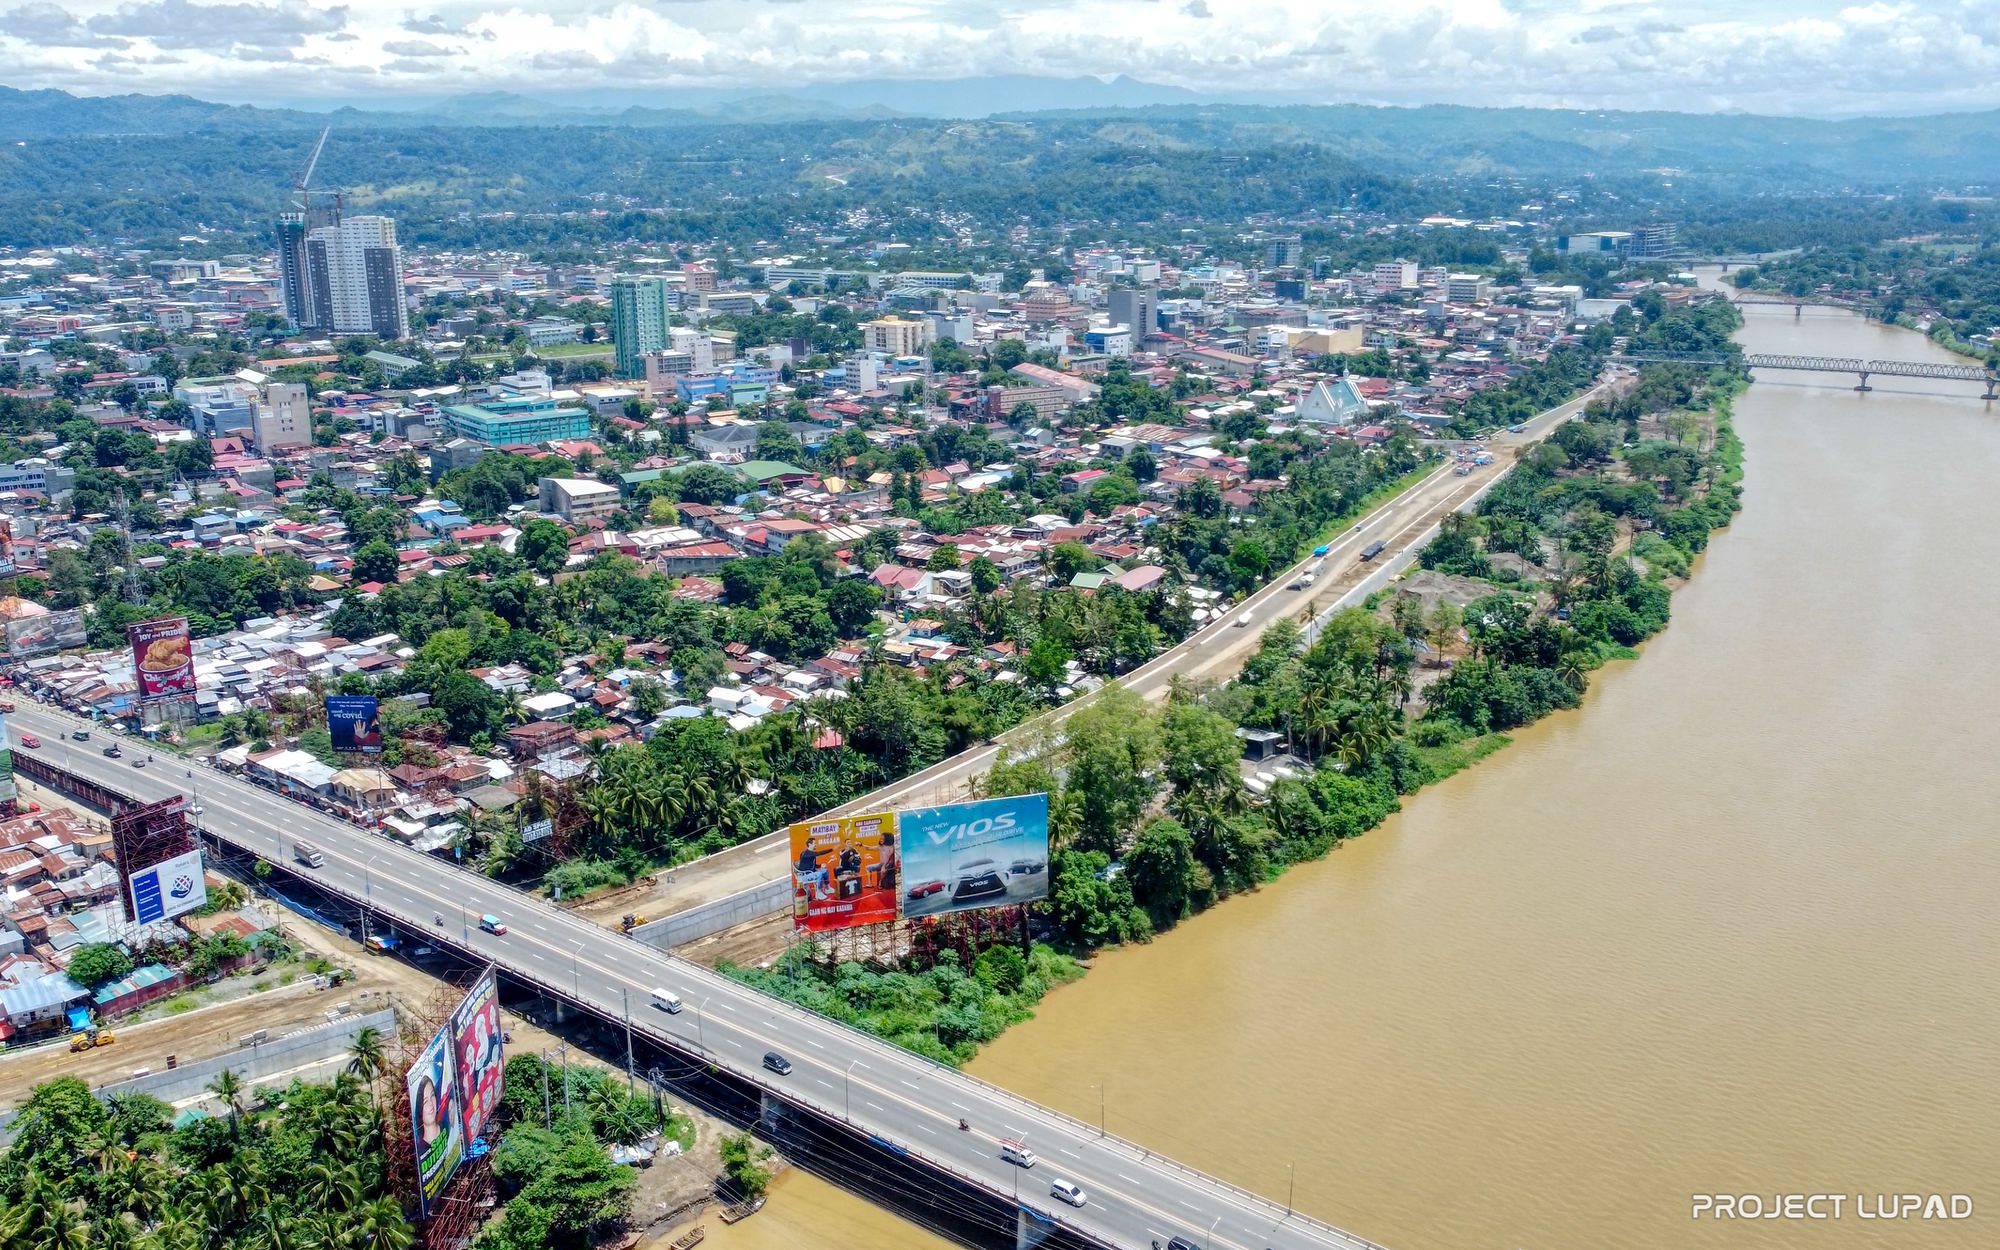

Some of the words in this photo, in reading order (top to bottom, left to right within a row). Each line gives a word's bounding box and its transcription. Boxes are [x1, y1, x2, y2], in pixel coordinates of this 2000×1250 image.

[139, 634, 151, 642] JOY
[812, 824, 837, 834] MATIBAY
[928, 812, 1017, 845] VIOS
[969, 880, 989, 888] VIOS
